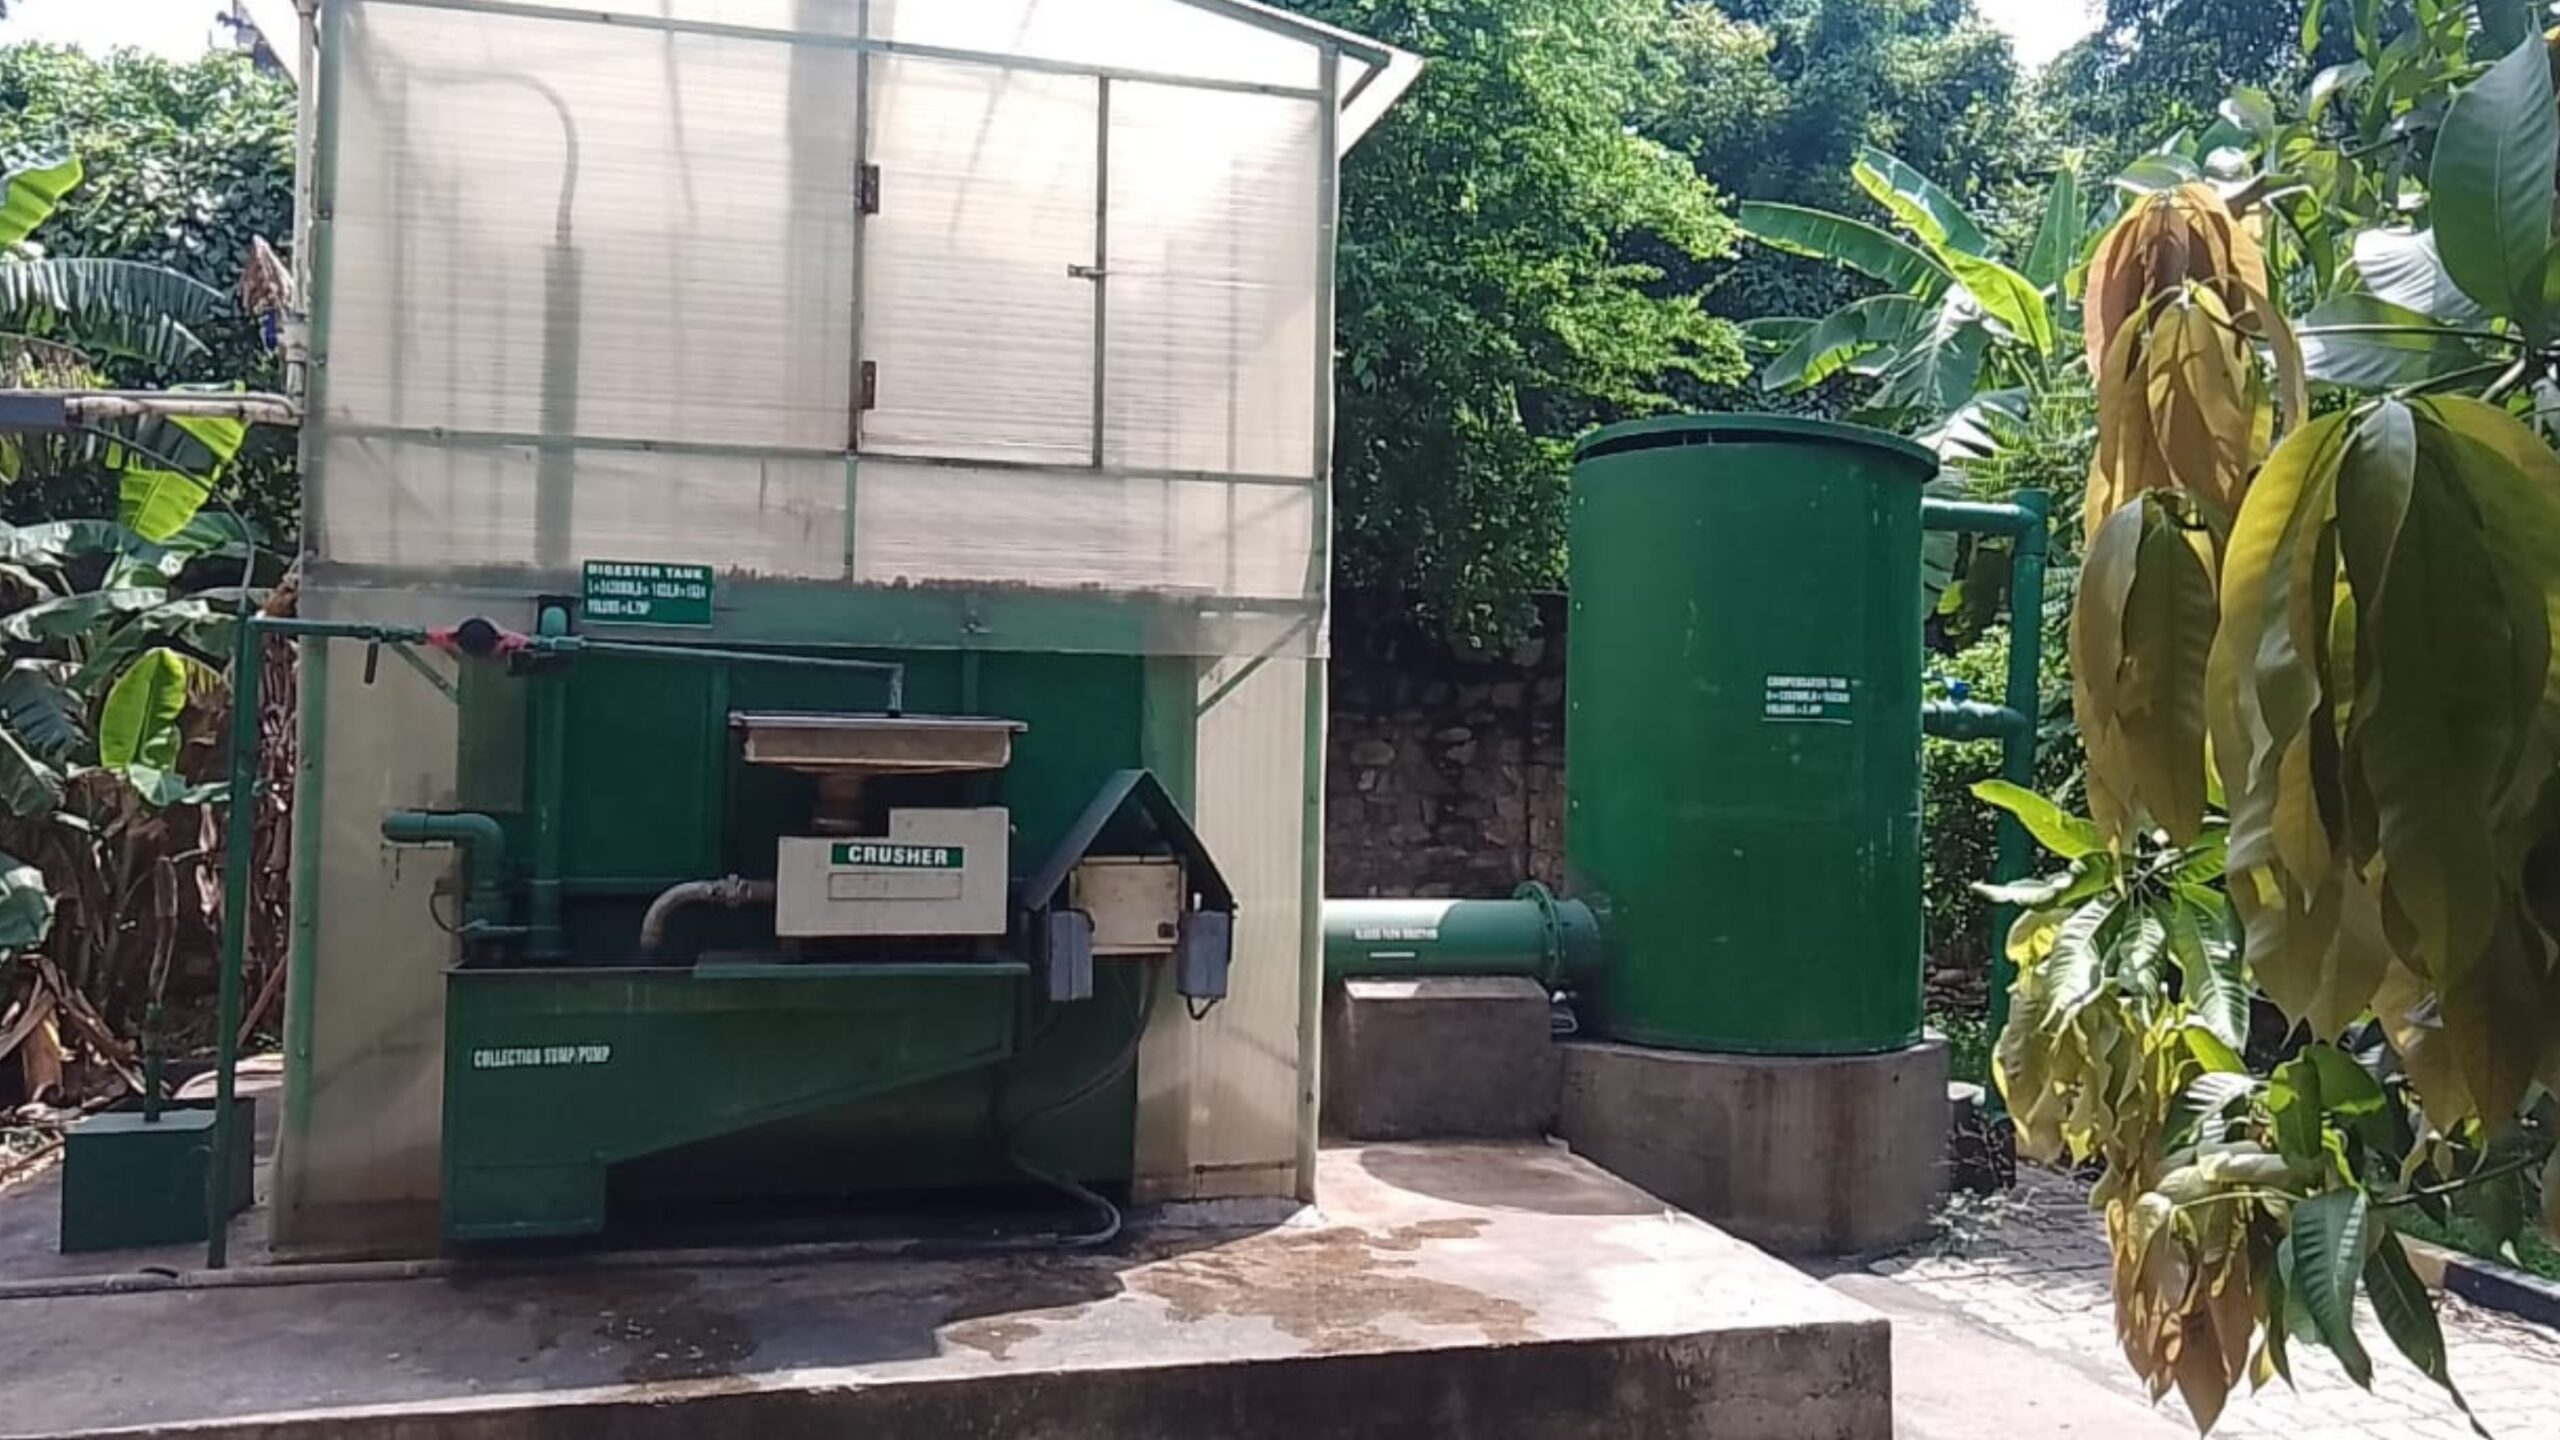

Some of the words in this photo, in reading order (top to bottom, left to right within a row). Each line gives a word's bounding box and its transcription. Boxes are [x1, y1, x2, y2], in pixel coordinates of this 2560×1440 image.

[587, 564, 661, 577] DIGESTER
[665, 567, 703, 579] TANK
[848, 846, 949, 866] CRUSHER
[474, 1048, 541, 1068] COLLECTION
